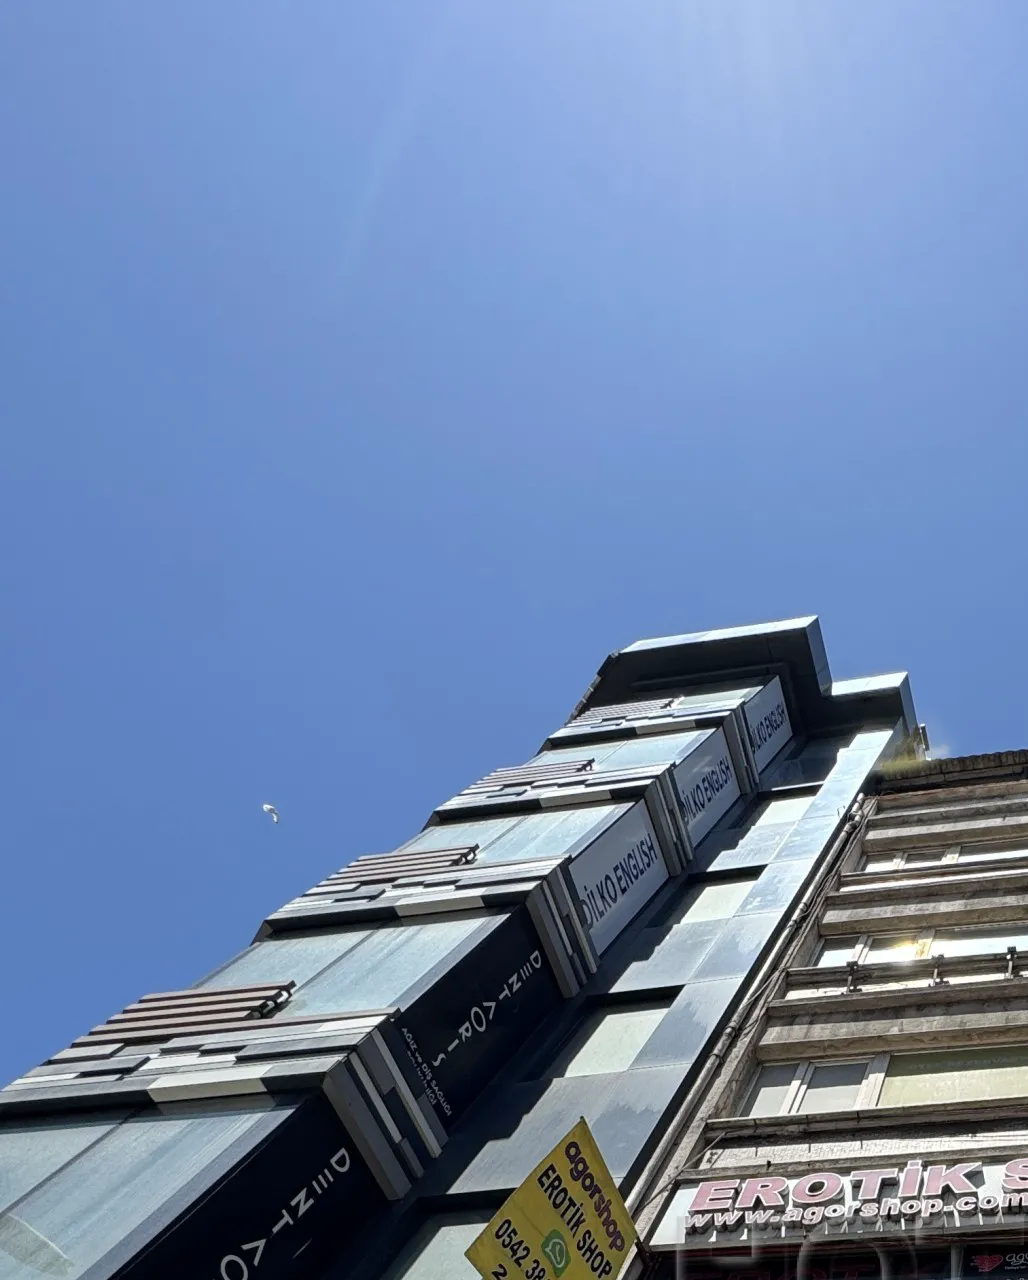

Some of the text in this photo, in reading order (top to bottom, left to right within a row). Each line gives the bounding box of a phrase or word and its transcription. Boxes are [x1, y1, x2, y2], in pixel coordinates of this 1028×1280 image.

[701, 755, 733, 803] ENGLISH
[579, 832, 658, 930] DİLKO ENGLISH
[537, 1163, 613, 1280] EROTİK SHOP
[565, 1141, 626, 1252] agorshop
[687, 1158, 984, 1212] EROTİK
[494, 1218, 531, 1268] 0542
